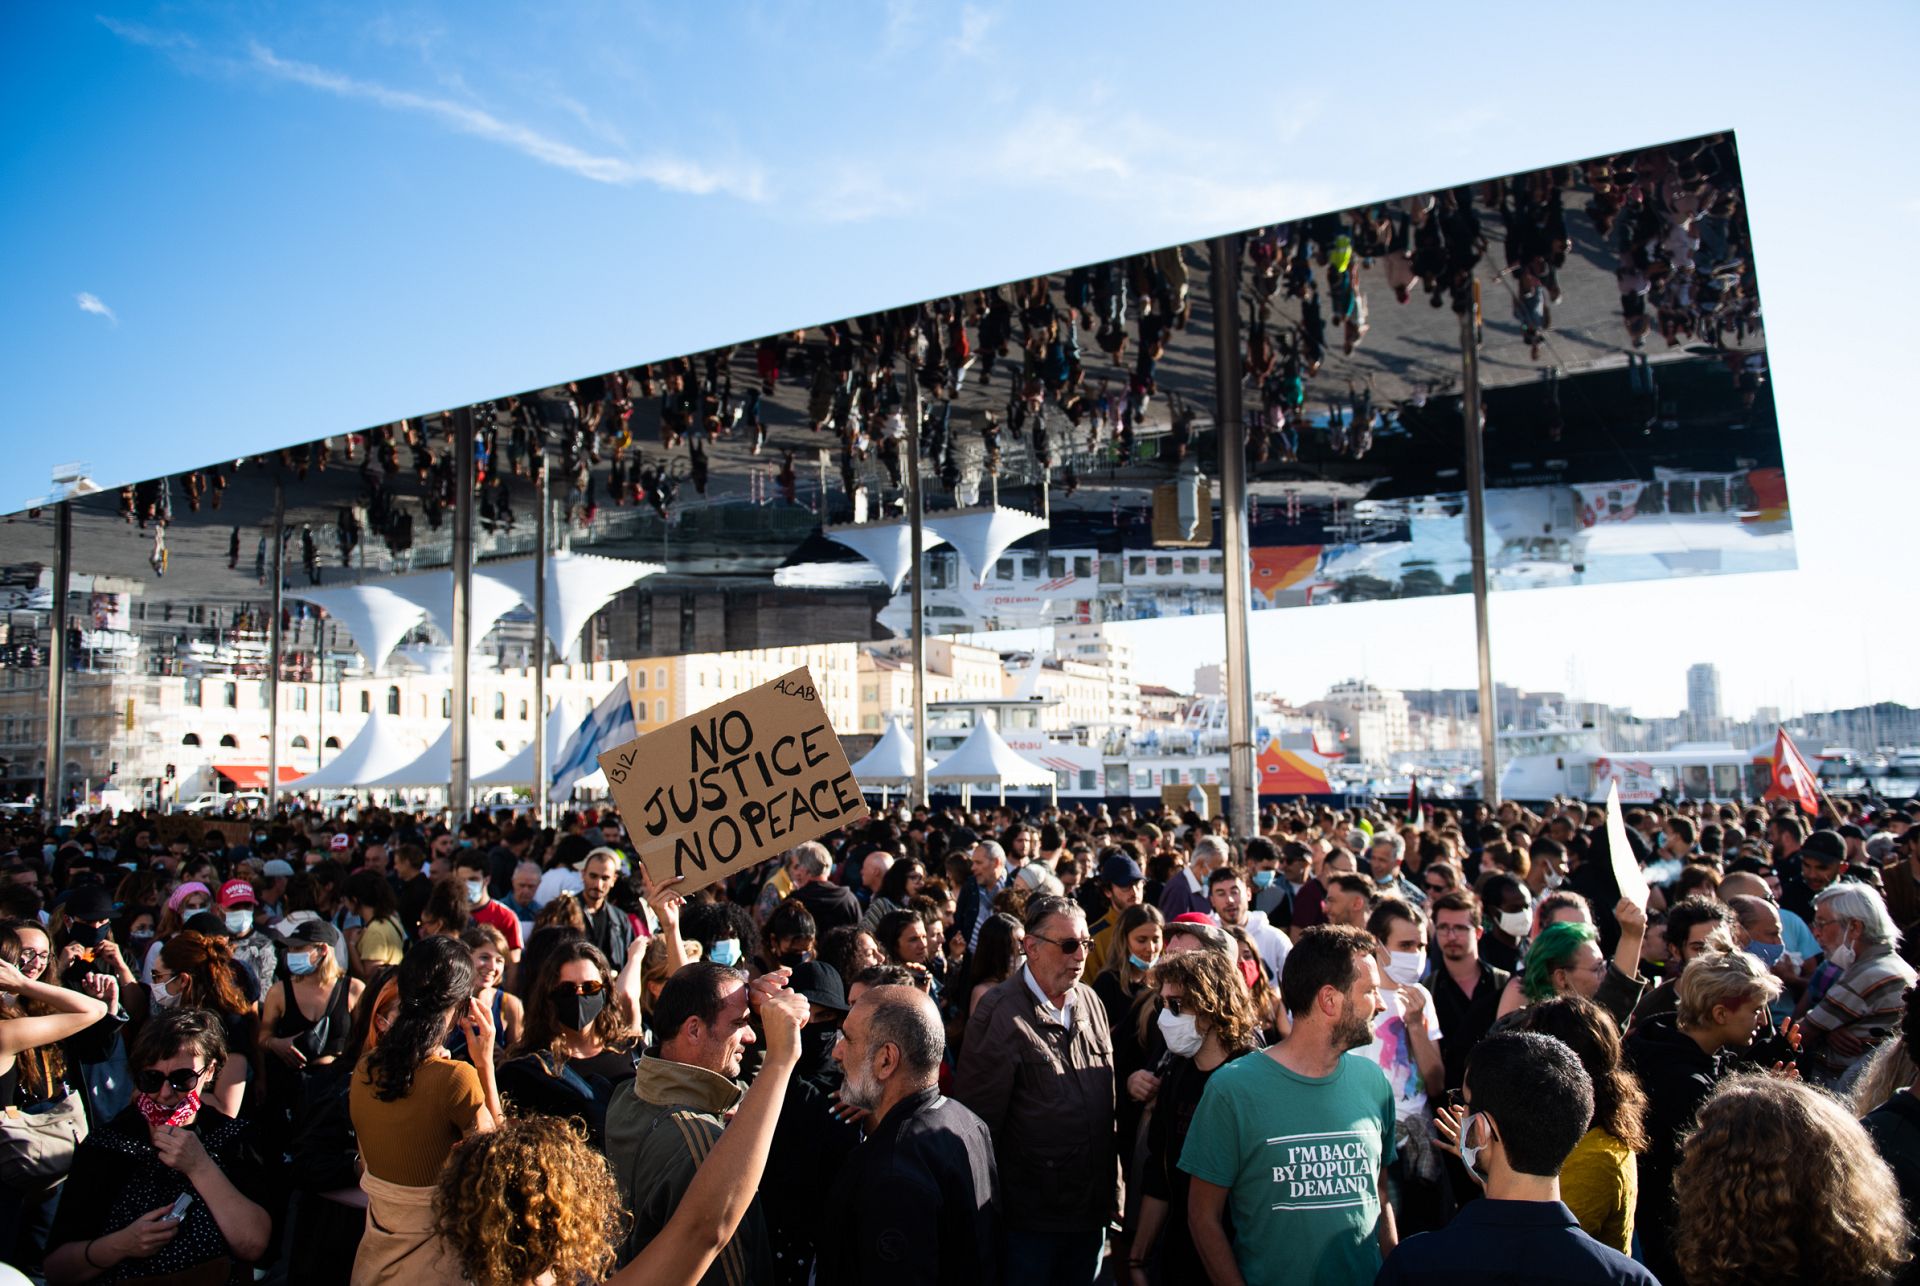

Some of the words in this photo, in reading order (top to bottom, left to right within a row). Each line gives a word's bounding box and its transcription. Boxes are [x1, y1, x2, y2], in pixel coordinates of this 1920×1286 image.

[774, 679, 815, 701] ACAB
[691, 710, 753, 772] NO
[610, 749, 637, 784] 1312
[644, 725, 829, 836] JUSTICE
[675, 815, 741, 876] NO
[740, 771, 859, 847] PEACE
[1320, 1142, 1368, 1161] BACK
[1272, 1165, 1297, 1182] BY
[1301, 1159, 1372, 1180] POPULA
[1290, 1176, 1368, 1198] DEMAND
